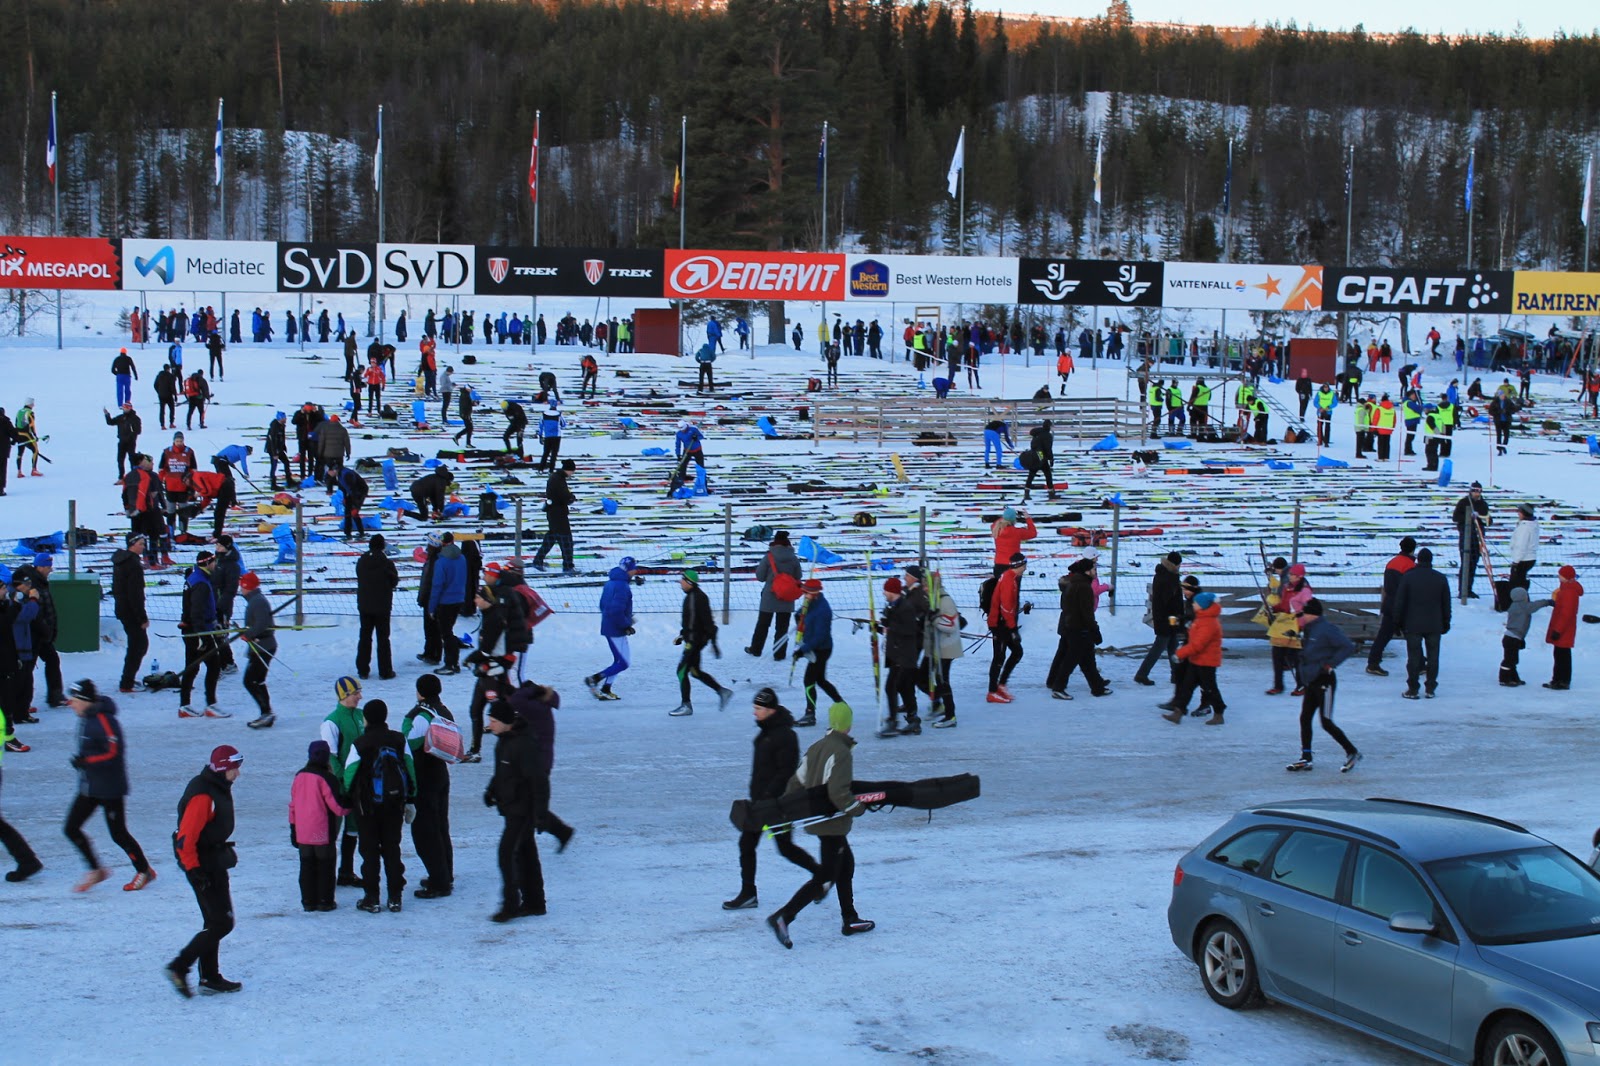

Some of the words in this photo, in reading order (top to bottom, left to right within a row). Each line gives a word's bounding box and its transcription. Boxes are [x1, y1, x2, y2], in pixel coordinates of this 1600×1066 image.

[0, 256, 24, 276] IX
[27, 262, 112, 278] MEGAPOL
[187, 257, 265, 275] Mediatec
[283, 247, 373, 289] SvD
[383, 249, 469, 289] SvD
[513, 266, 559, 276] TREK
[608, 268, 653, 278] TREK
[1047, 263, 1065, 281] SJ
[1119, 265, 1136, 283] SJ
[720, 262, 840, 292] ENERVIT
[851, 280, 888, 292] Western
[859, 272, 879, 282] Best
[896, 273, 922, 285] Best
[926, 275, 972, 286] Western
[976, 275, 1012, 287] Hotels
[1169, 280, 1232, 290] VATTENFALL
[1336, 275, 1466, 306] CRAFT
